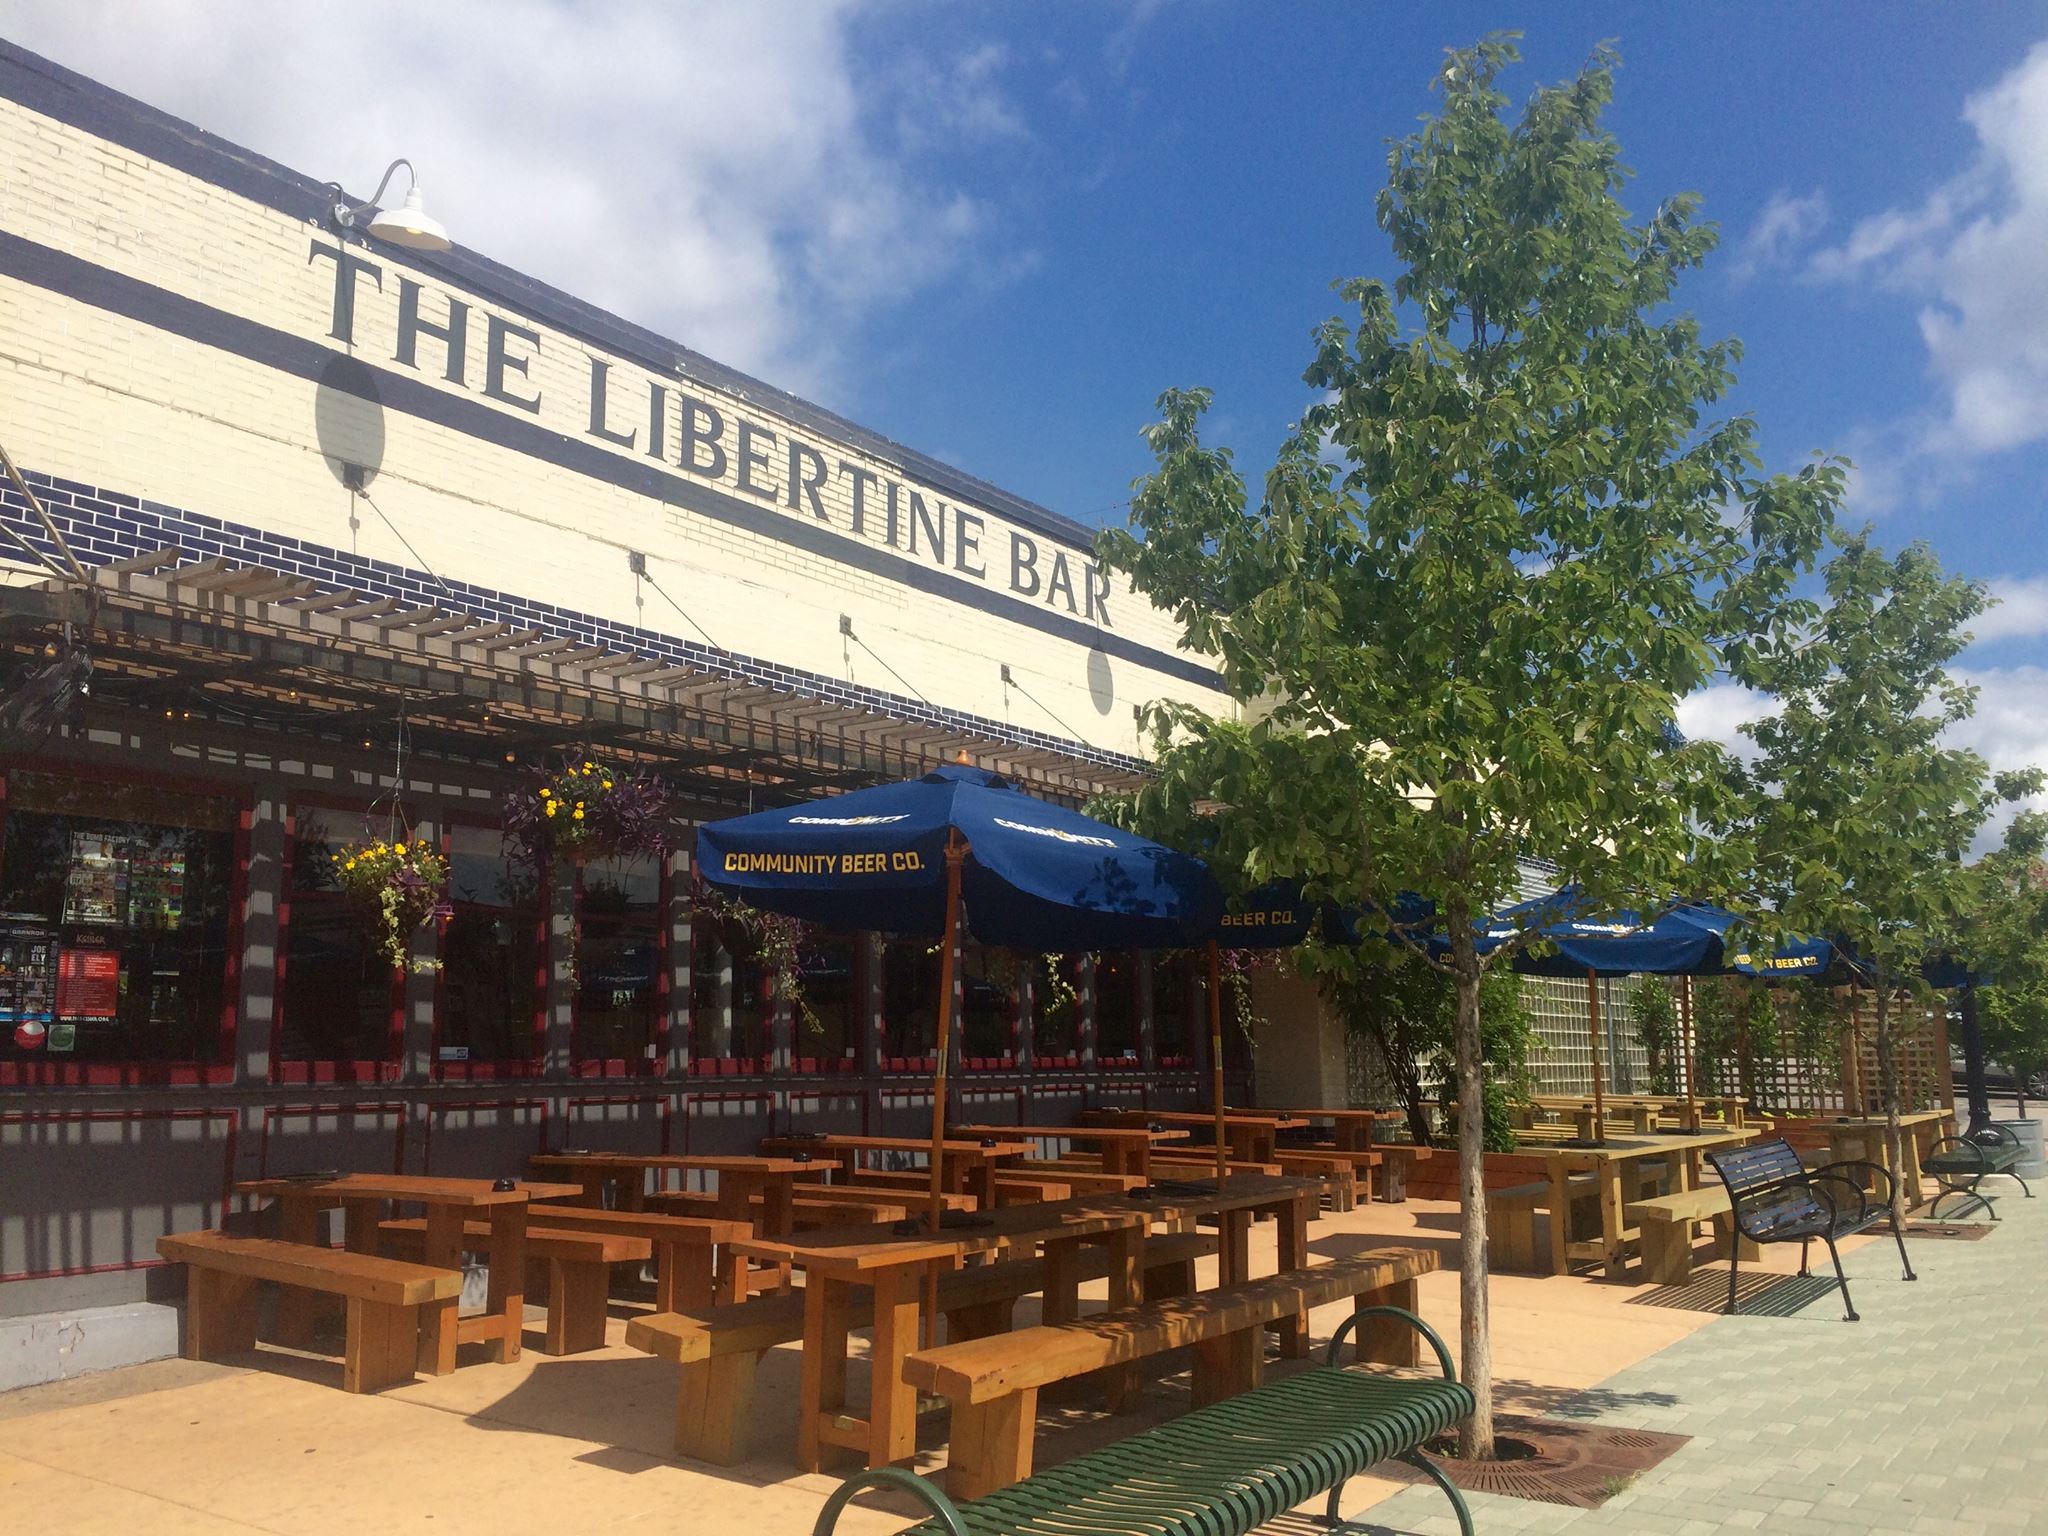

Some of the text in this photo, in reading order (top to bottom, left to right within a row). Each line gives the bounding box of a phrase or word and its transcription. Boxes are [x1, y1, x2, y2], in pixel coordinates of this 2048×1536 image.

[308, 239, 1114, 628] THE LIBERTINE BAR
[724, 851, 925, 874] COMMUNITY BEER CO.
[1221, 911, 1297, 926] BEER CO.
[31, 945, 47, 954] JOE
[31, 954, 46, 962] ELY
[1775, 957, 1802, 969] BEER
